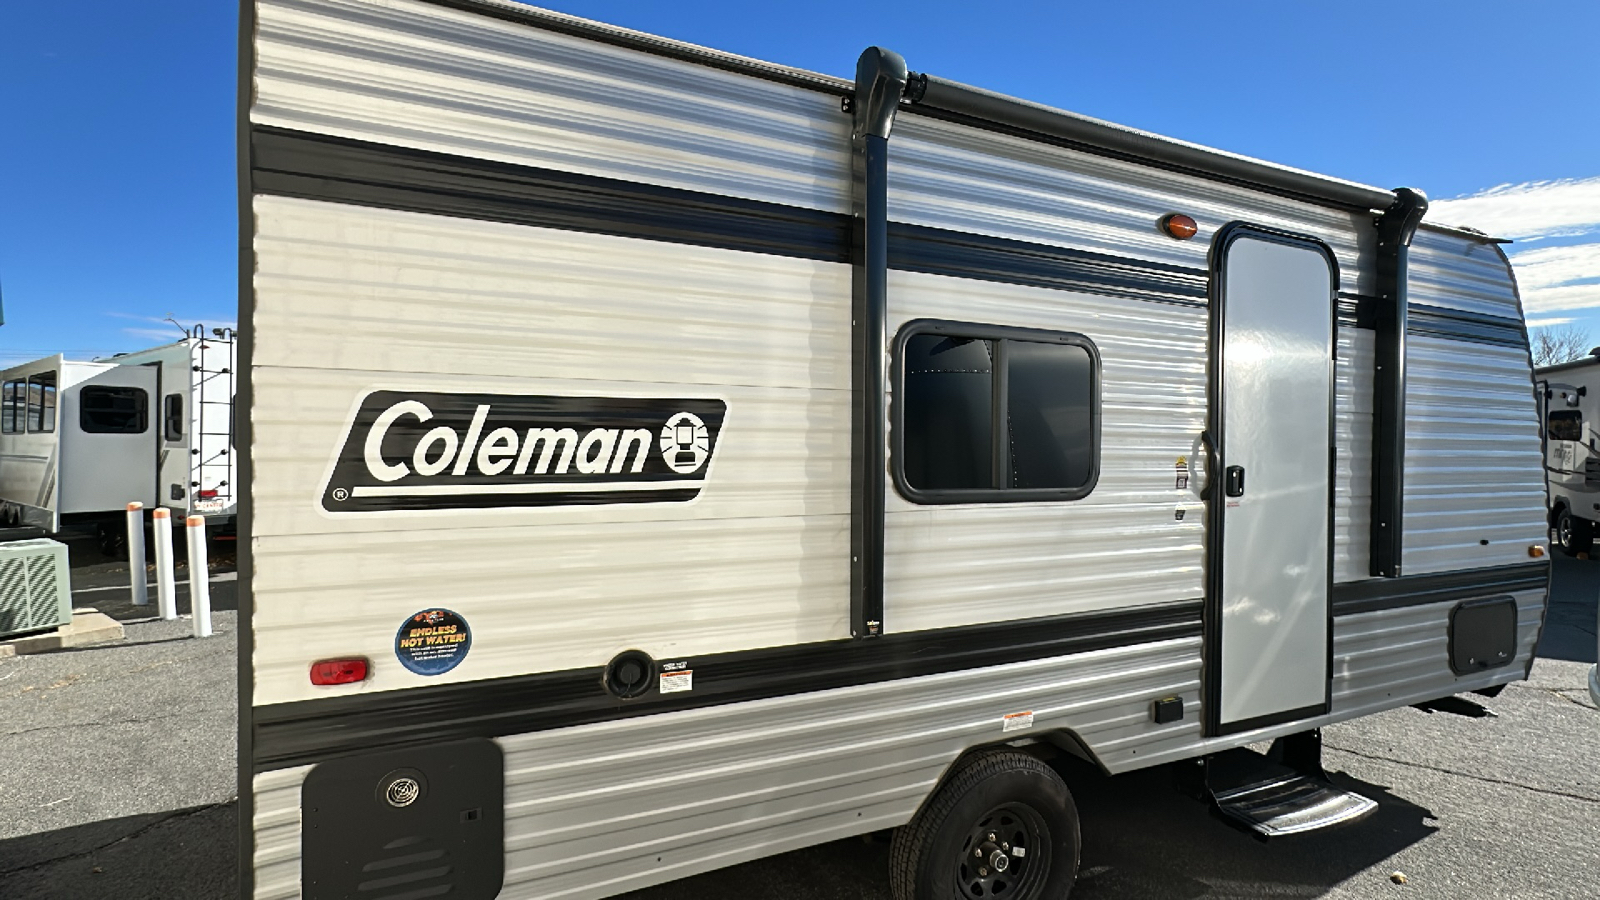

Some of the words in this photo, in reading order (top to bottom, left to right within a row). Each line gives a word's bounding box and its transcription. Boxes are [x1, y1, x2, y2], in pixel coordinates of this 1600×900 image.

[364, 400, 653, 482] Coleman
[409, 625, 457, 637] ENDLESS
[400, 637, 424, 648] HOT
[426, 633, 466, 644] WATER!
